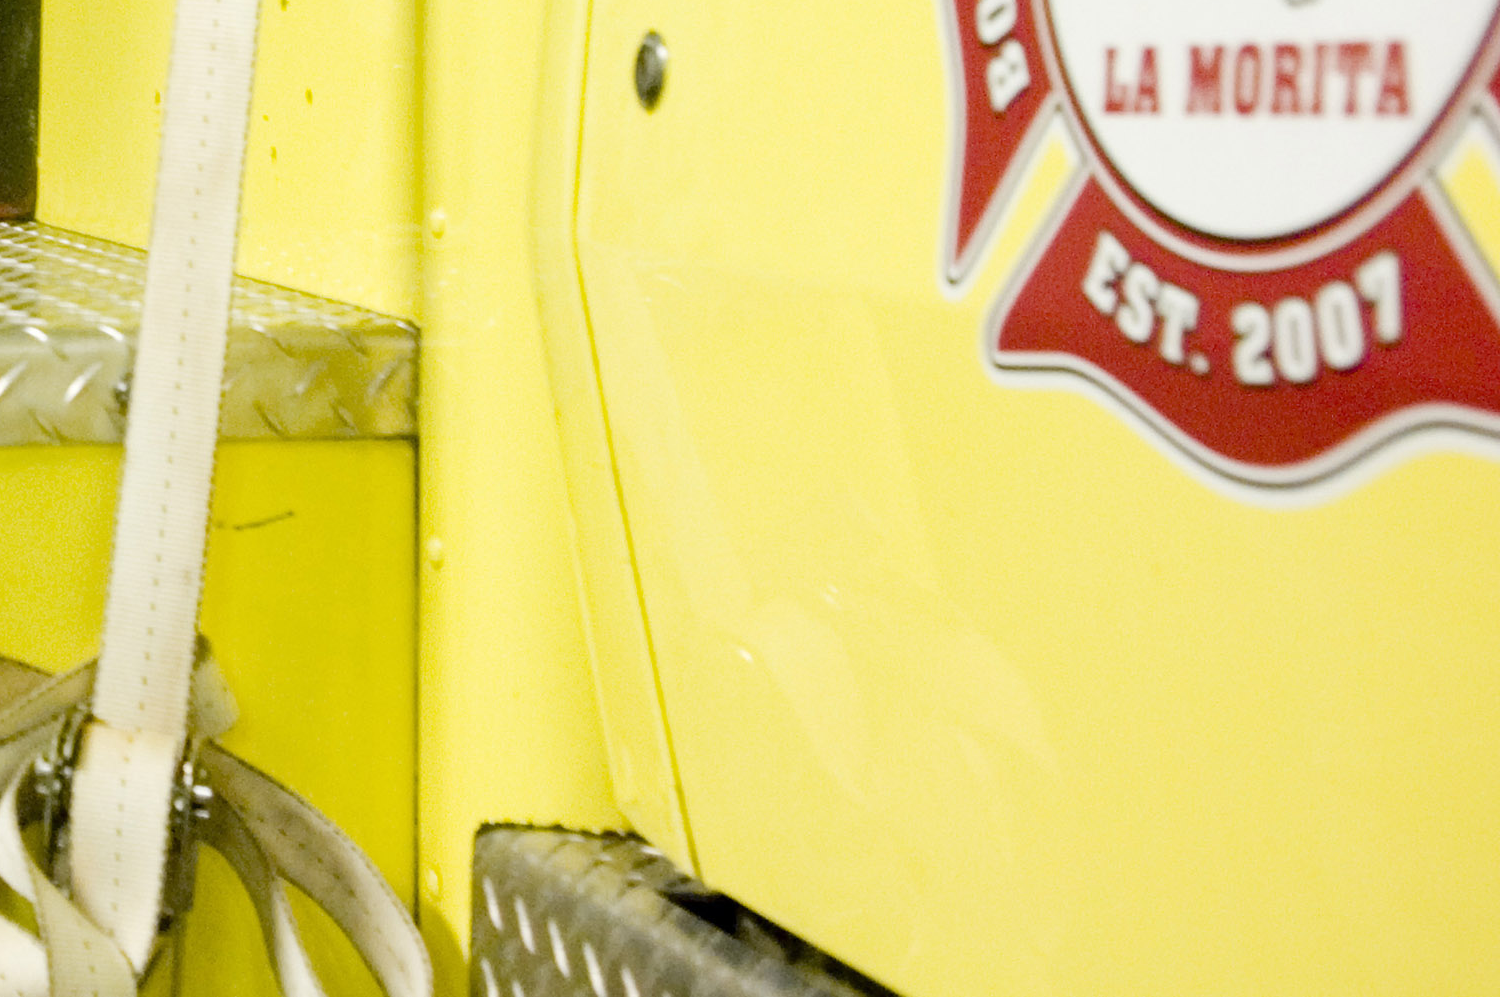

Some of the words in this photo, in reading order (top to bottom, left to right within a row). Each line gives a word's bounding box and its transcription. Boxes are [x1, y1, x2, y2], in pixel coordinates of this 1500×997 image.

[1103, 45, 1162, 114] LA
[1185, 41, 1411, 116] MORITA
[1082, 230, 1211, 375] EST.
